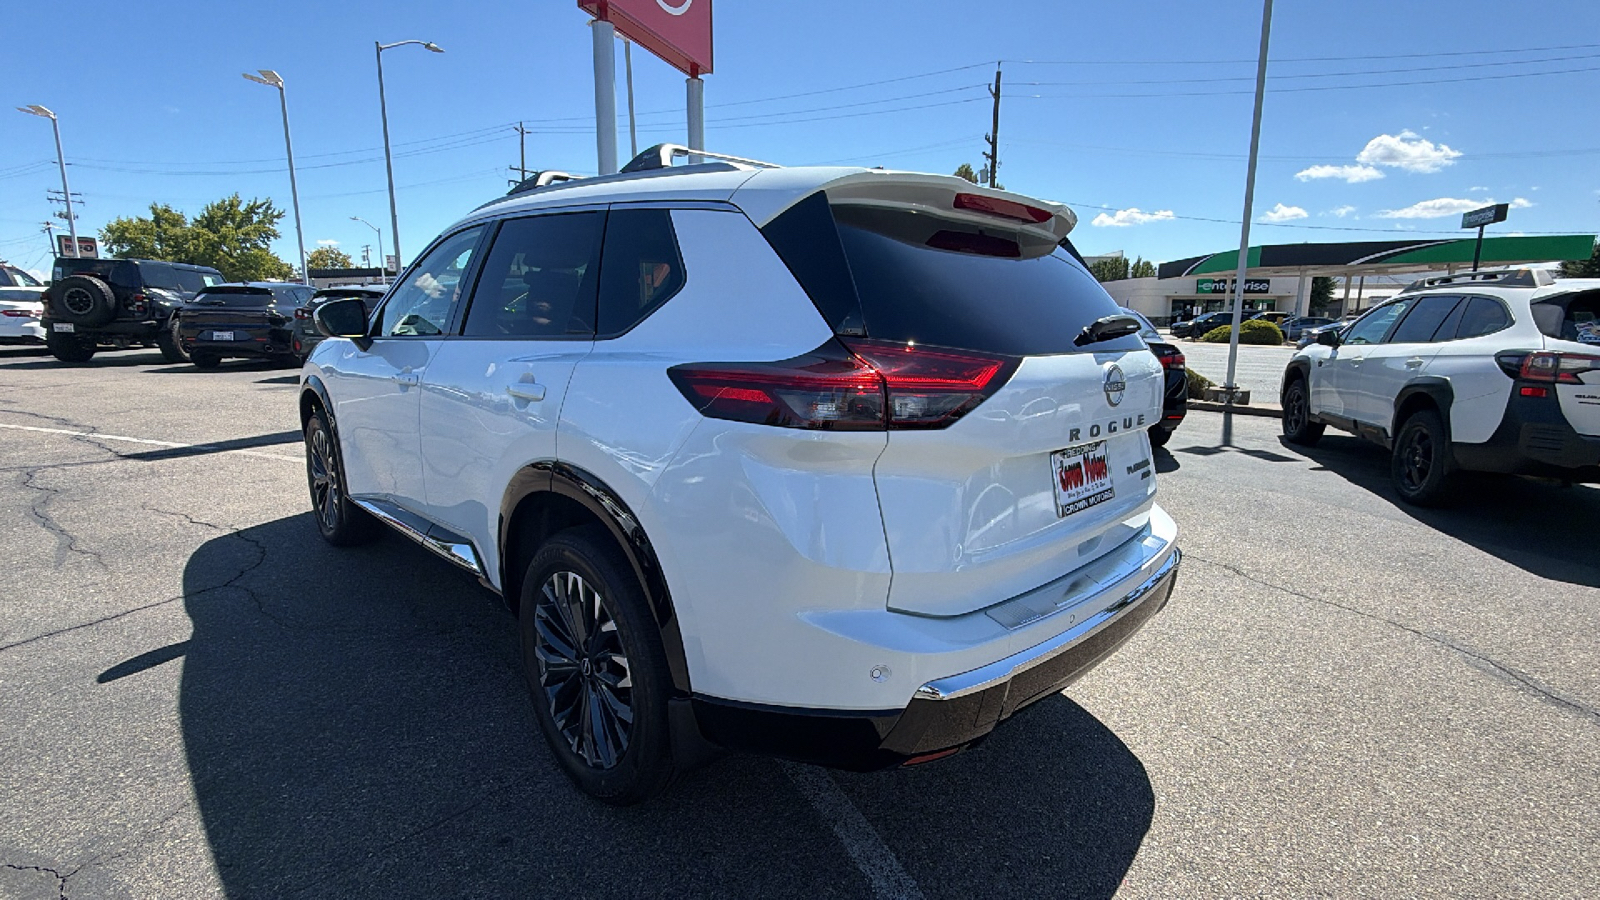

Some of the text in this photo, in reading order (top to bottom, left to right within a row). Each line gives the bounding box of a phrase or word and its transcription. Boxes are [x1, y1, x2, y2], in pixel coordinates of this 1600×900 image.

[1198, 281, 1269, 291] entrrise
[1068, 414, 1145, 442] ROGUE
[1066, 443, 1096, 457] REDDING
[1065, 499, 1089, 514] CROWN
[1089, 489, 1113, 506] MOTORS
